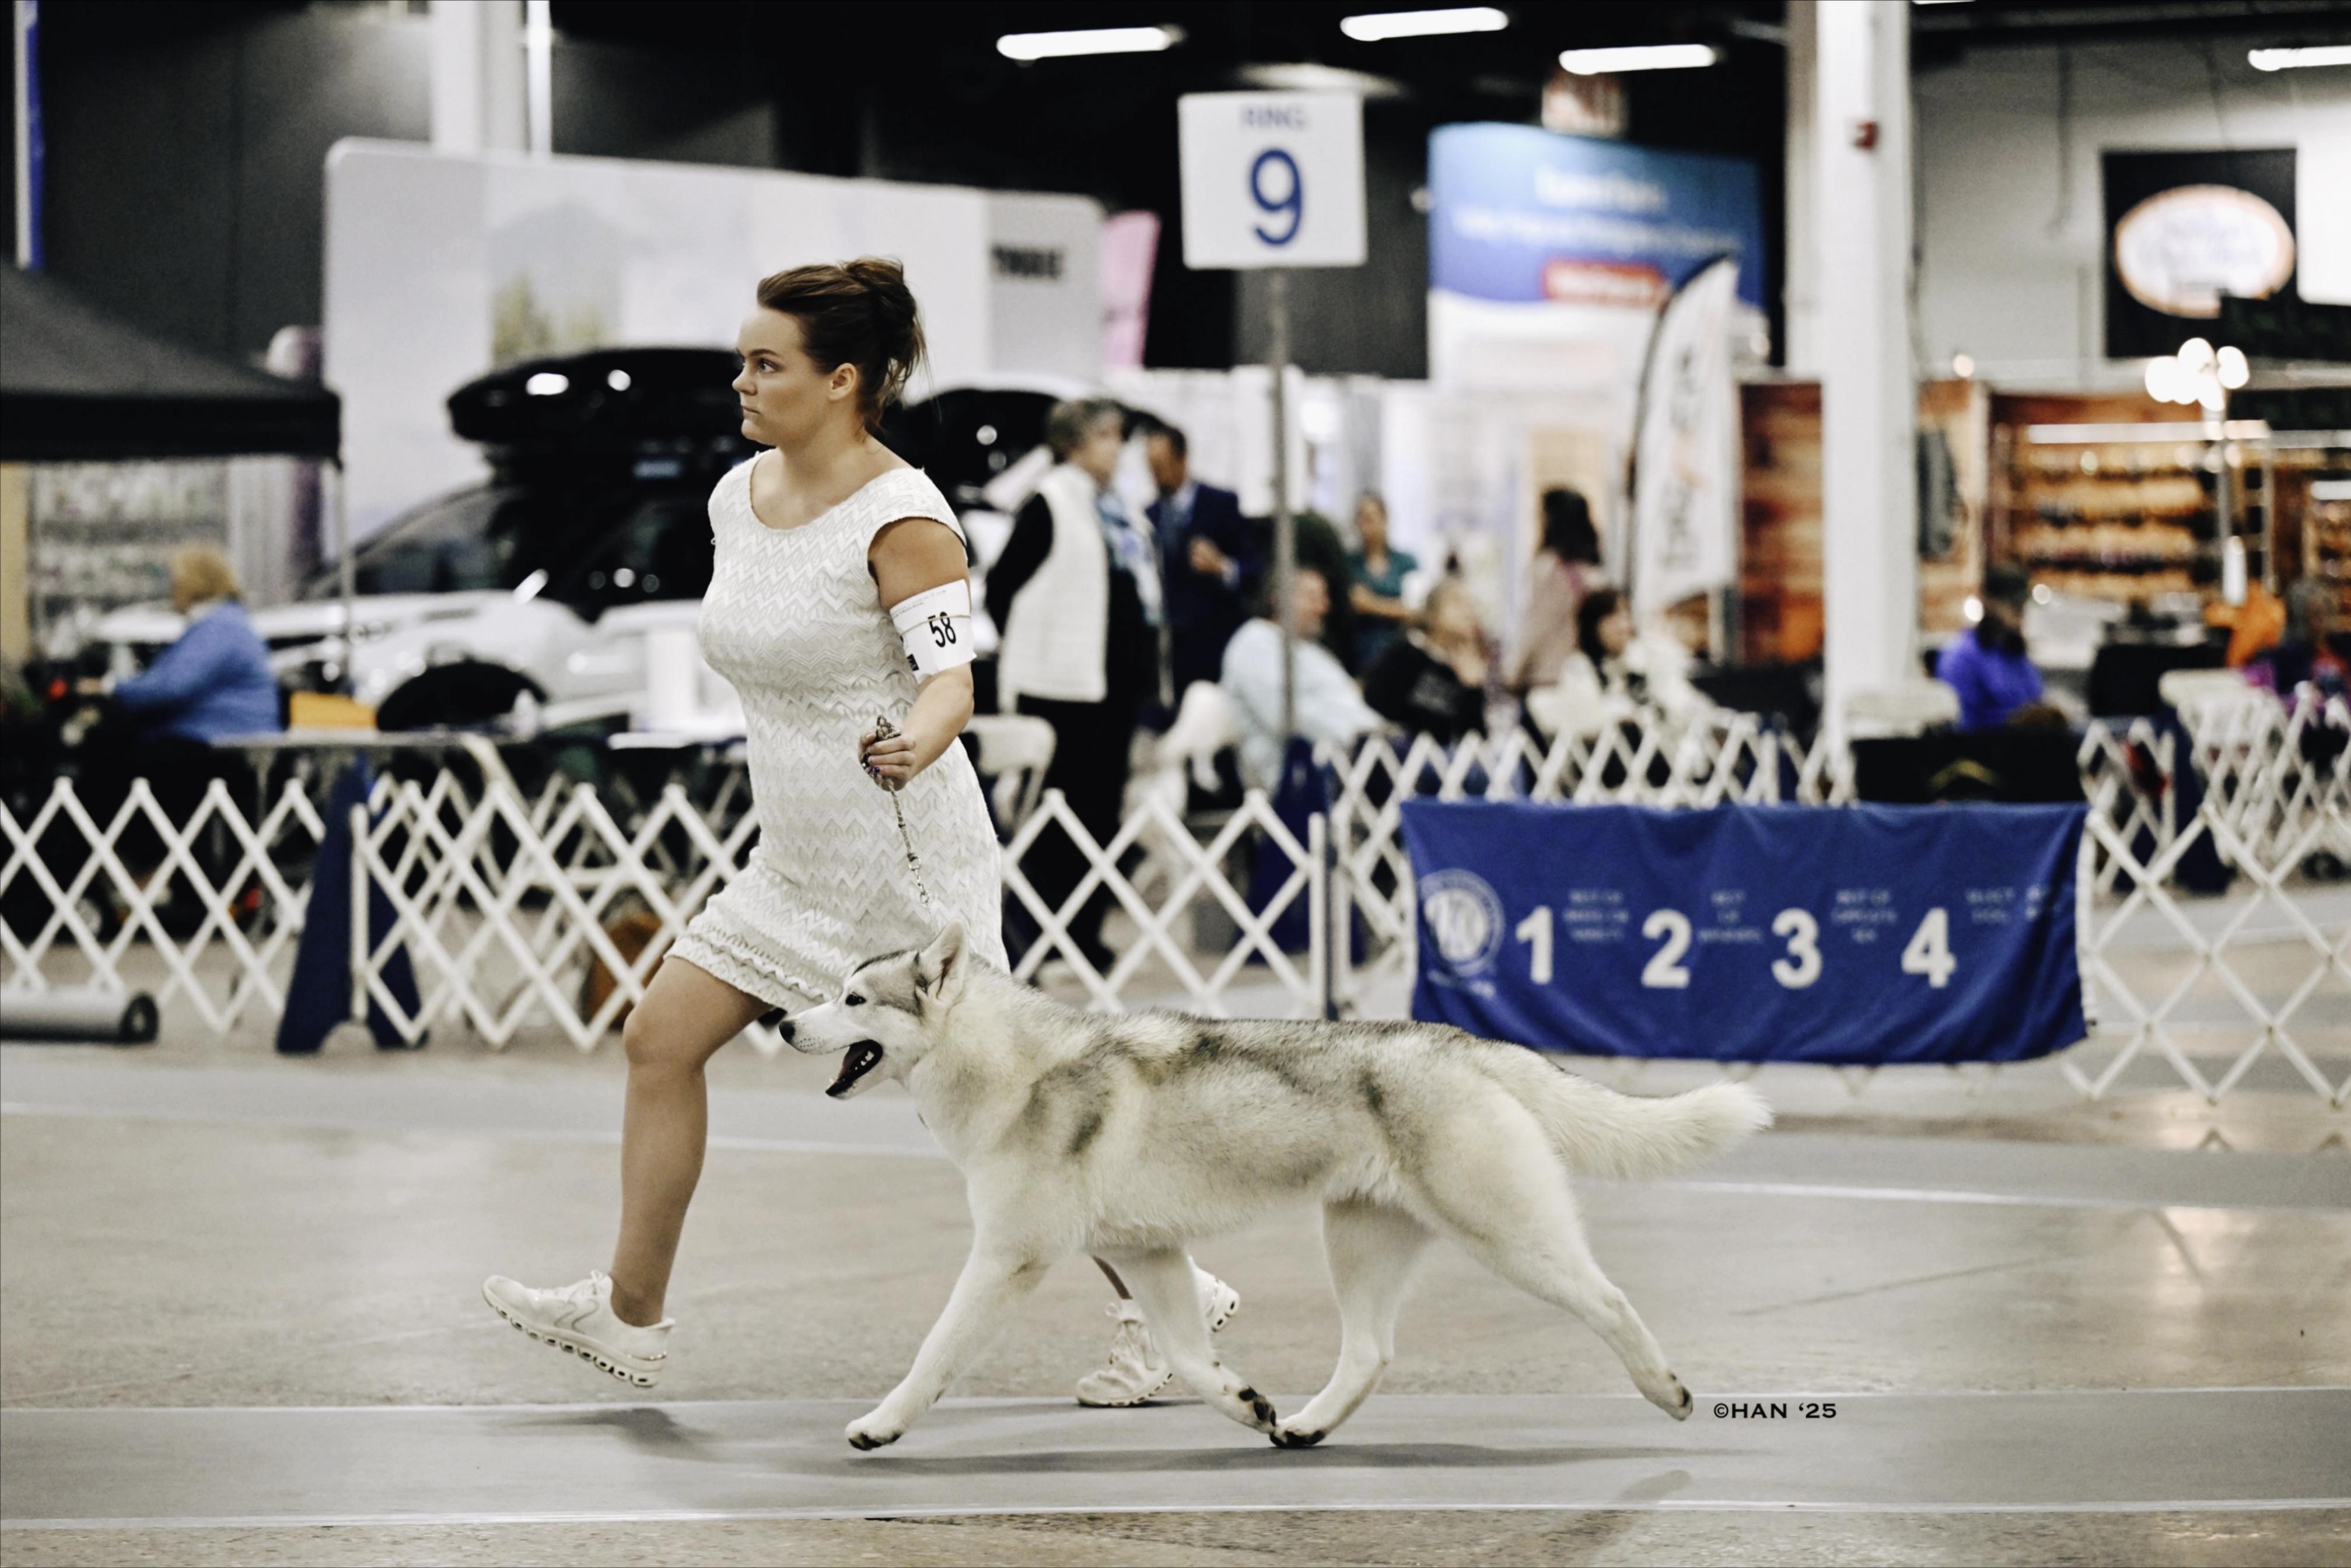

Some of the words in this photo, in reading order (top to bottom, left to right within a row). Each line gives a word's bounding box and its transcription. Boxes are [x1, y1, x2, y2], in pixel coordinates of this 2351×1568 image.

[1250, 148, 1303, 247] 9
[928, 611, 957, 648] 58
[1516, 905, 1553, 985] 1
[1642, 908, 1691, 988] 2
[1772, 907, 1822, 988] 3
[1901, 907, 1956, 988] 4
